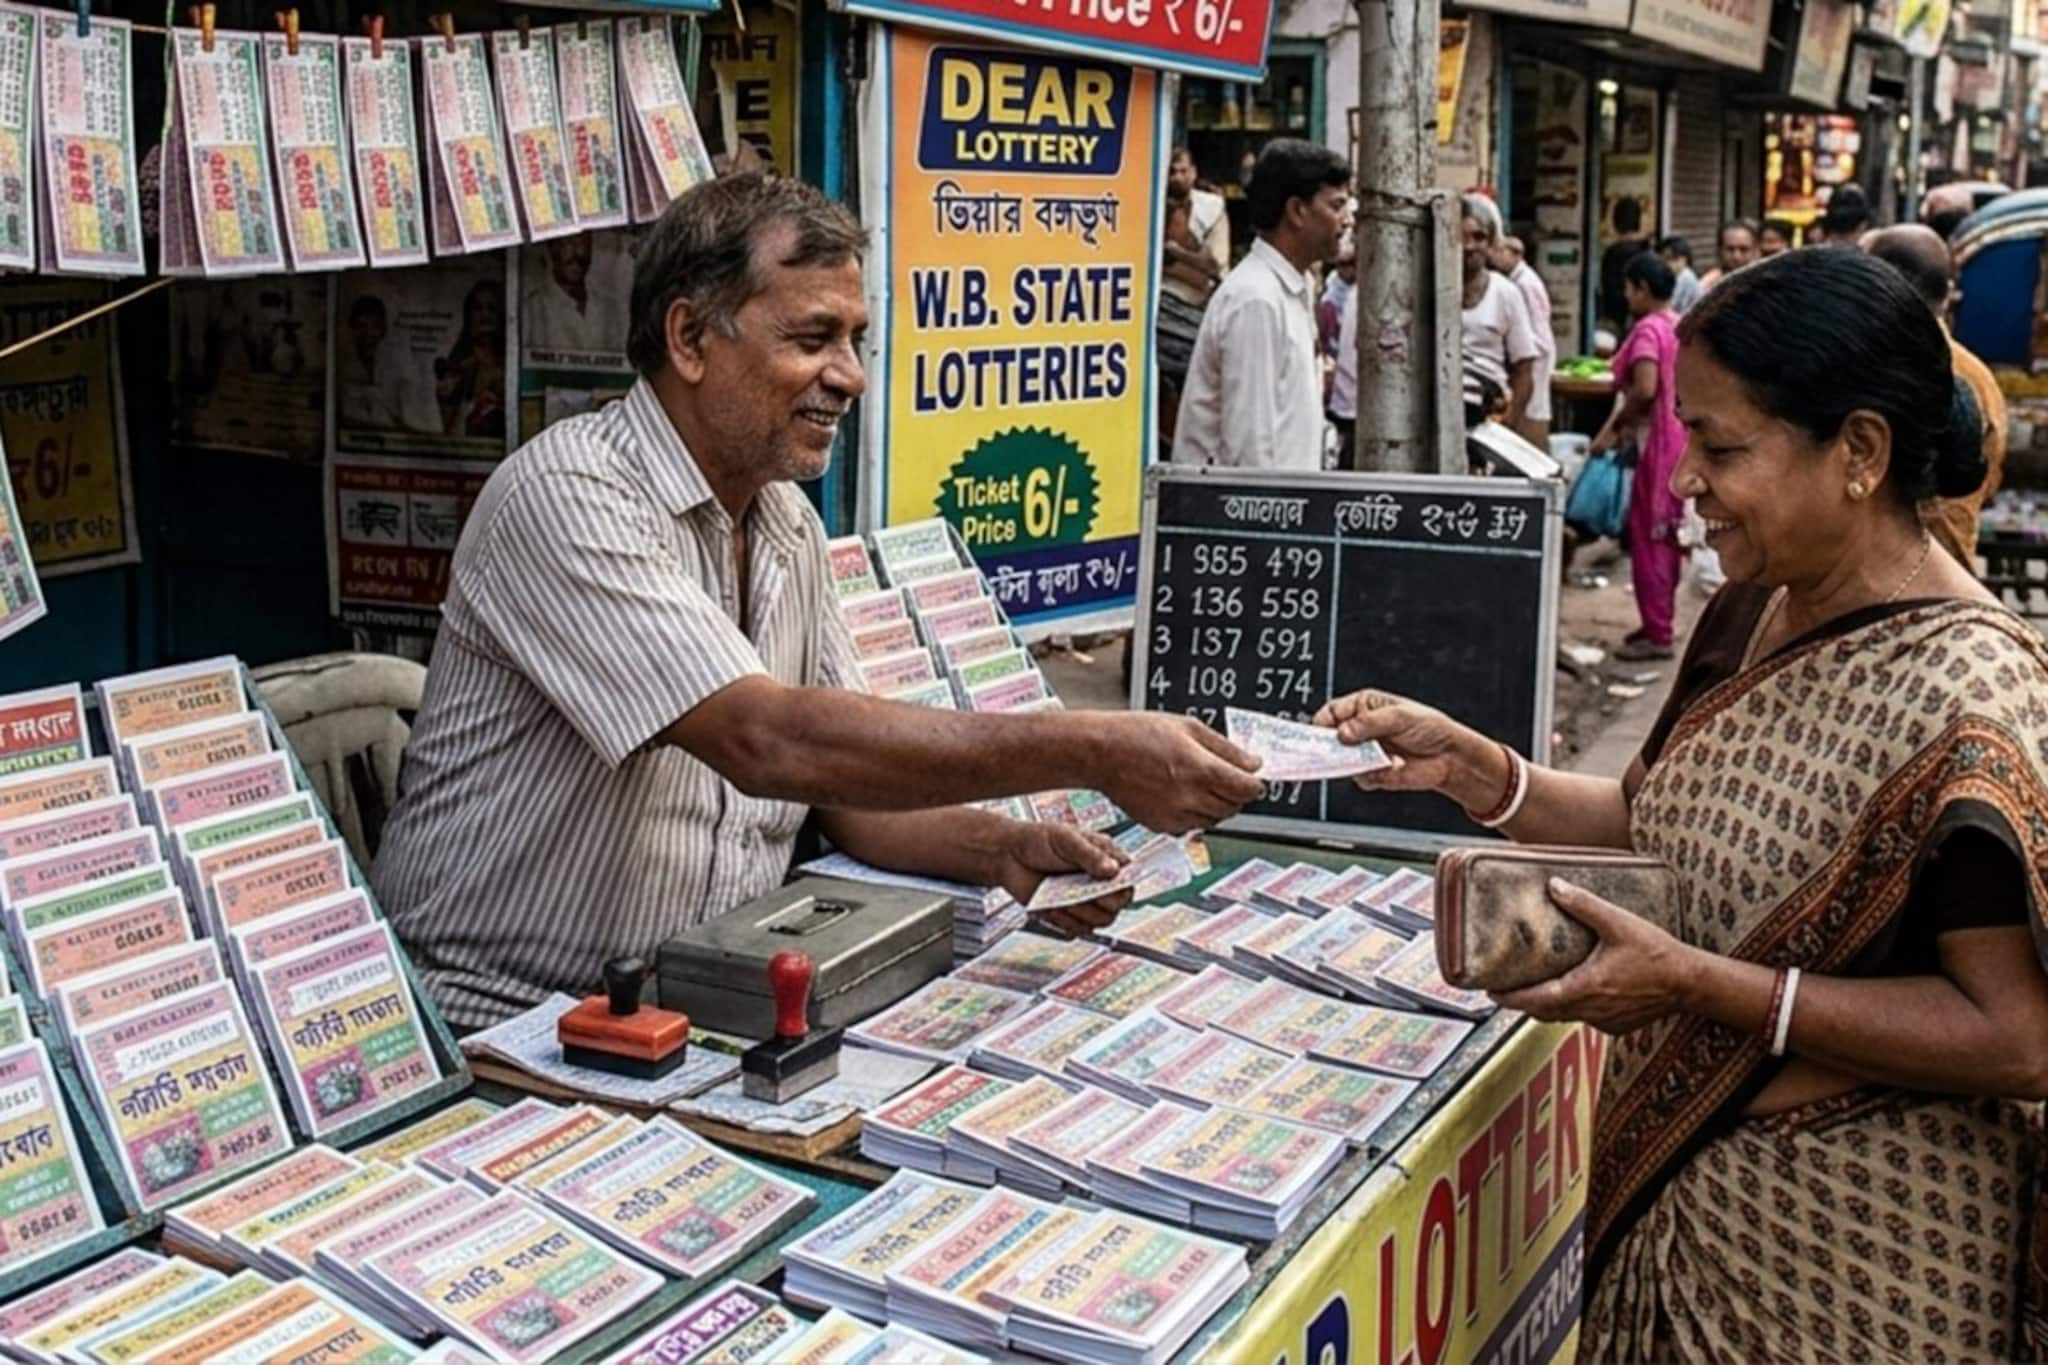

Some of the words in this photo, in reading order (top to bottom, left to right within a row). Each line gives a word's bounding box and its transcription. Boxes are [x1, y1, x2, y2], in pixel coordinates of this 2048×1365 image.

[941, 59, 1116, 129] DEAR
[956, 130, 1100, 165] LOTTERY
[914, 268, 998, 329] W.B.
[1013, 266, 1132, 326] STATE
[914, 343, 1127, 412] LOTTERIES
[954, 476, 1020, 508] Ticket
[1023, 465, 1080, 539] 6/-
[963, 514, 1016, 545] Price
[1156, 585, 1174, 613] 2
[1191, 586, 1244, 618] 136
[1260, 587, 1320, 620] 558
[1153, 625, 1171, 655] 3
[1256, 627, 1314, 662] 691
[1150, 665, 1171, 696] 4
[1188, 665, 1237, 699] 108
[1256, 667, 1313, 705] 574
[1379, 1024, 1605, 1365] LOTTERY
